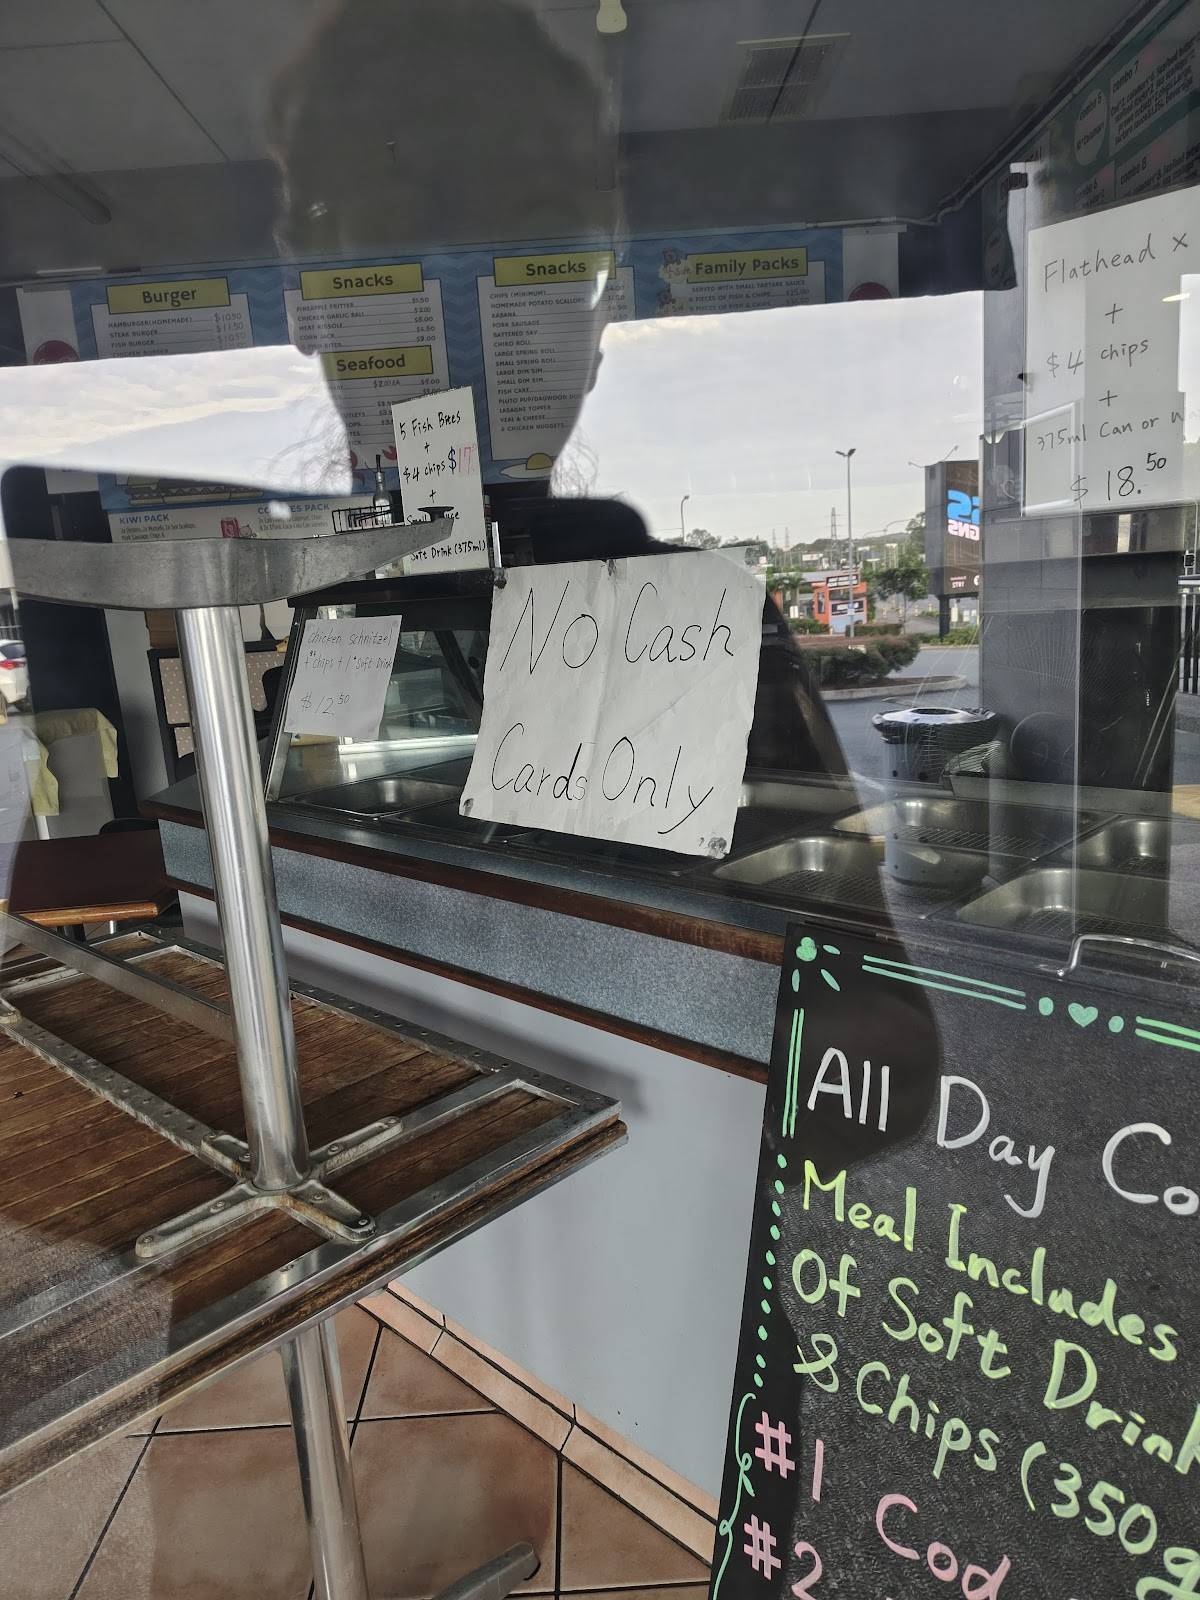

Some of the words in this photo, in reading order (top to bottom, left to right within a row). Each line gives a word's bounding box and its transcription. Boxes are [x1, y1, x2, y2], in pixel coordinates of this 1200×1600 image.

[526, 260, 586, 276] Snacks
[696, 260, 746, 275] Family
[752, 257, 799, 271] Packs
[1044, 232, 1156, 293] Flathead
[333, 274, 394, 289] Snacks
[142, 288, 197, 307] Burger
[528, 299, 553, 307] POTATO
[327, 312, 349, 320] GARLIC
[1105, 303, 1124, 324] +
[132, 329, 158, 337] BURGER
[129, 340, 154, 348] BURGER
[1101, 340, 1149, 367] chips
[337, 354, 406, 372] Seafood
[1099, 390, 1118, 407] +
[400, 423, 406, 440] 5
[412, 416, 434, 436] Fish
[438, 410, 461, 428] Bites
[507, 424, 534, 432] CHICKEN
[536, 422, 564, 430] NUGGETS
[1038, 424, 1087, 451] 375ml
[1100, 422, 1133, 438] Can
[1142, 417, 1159, 430] or
[424, 442, 430, 453] +
[403, 466, 419, 483] $4
[424, 460, 446, 477] chips
[120, 516, 141, 524] KIWI
[144, 513, 169, 522] PACK
[431, 545, 453, 559] Drink
[454, 540, 487, 555] (375ml)
[624, 582, 734, 663] Cash
[492, 722, 588, 801] Cards
[602, 736, 714, 834] Only
[807, 1047, 890, 1132] All
[936, 1075, 1056, 1218] Day
[803, 1159, 917, 1252] Meal
[945, 1203, 1179, 1361] Includes
[792, 1249, 861, 1318] Of
[882, 1276, 1012, 1379] Soft
[793, 1334, 839, 1393] &
[856, 1358, 1000, 1481] Chips
